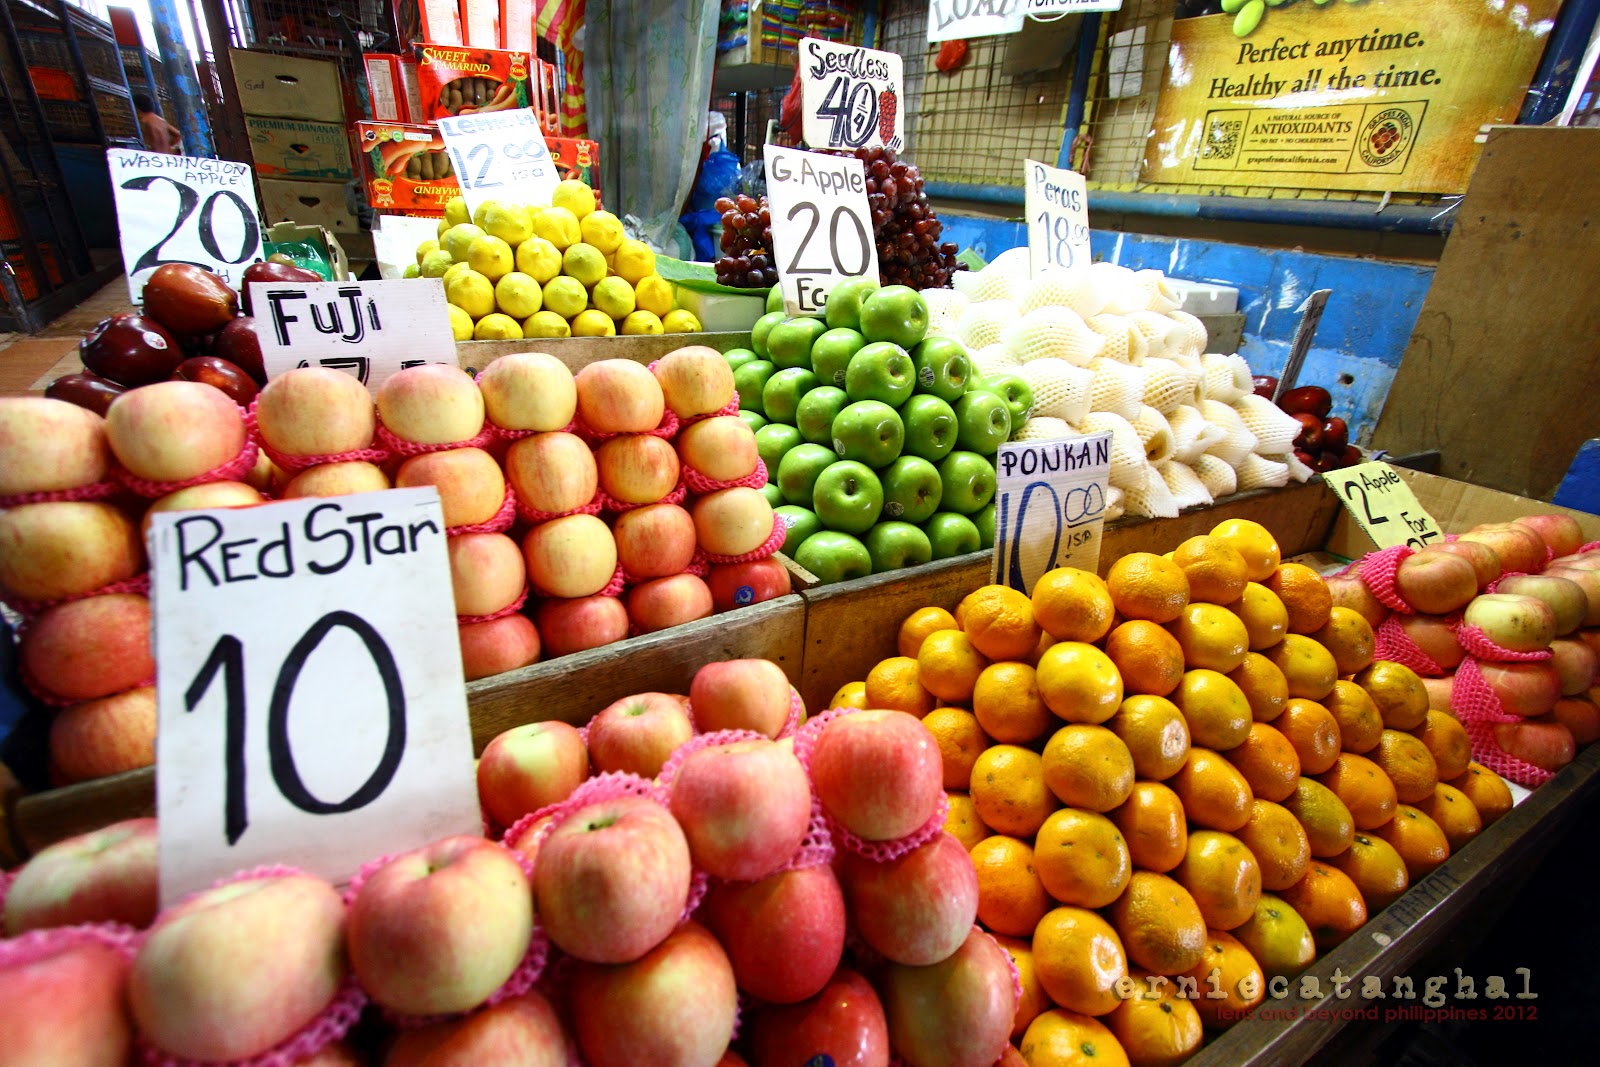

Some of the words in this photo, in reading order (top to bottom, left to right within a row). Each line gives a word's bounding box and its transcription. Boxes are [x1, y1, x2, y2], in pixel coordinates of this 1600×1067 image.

[421, 47, 470, 66] SWEET
[808, 42, 889, 80] Seedless
[1236, 37, 1310, 65] Perfect
[1315, 27, 1424, 62] anytime.
[433, 60, 490, 72] TAMARIND
[1207, 72, 1287, 100] Healthy
[1291, 68, 1322, 93] all
[1327, 65, 1366, 90] the
[1373, 64, 1441, 88] time.
[816, 76, 879, 147] 40
[1272, 113, 1301, 121] NATURAL
[1304, 112, 1329, 120] SOURCE
[249, 119, 297, 132] PREMIUM
[298, 123, 341, 136] BANANAS
[1251, 121, 1353, 135] ANTIOXIDANTS
[119, 153, 247, 176] WASHINGTON
[452, 143, 504, 190] 12
[1247, 154, 1338, 165] grapesfromcalifornia.com
[184, 171, 240, 186] APPLE
[413, 185, 463, 196] AMARIND
[120, 175, 260, 277] 20
[785, 201, 871, 277] 20
[1001, 439, 1108, 477] PONKAN
[1359, 470, 1400, 494] Apple
[996, 481, 1062, 600] 10
[184, 610, 407, 847] 10
